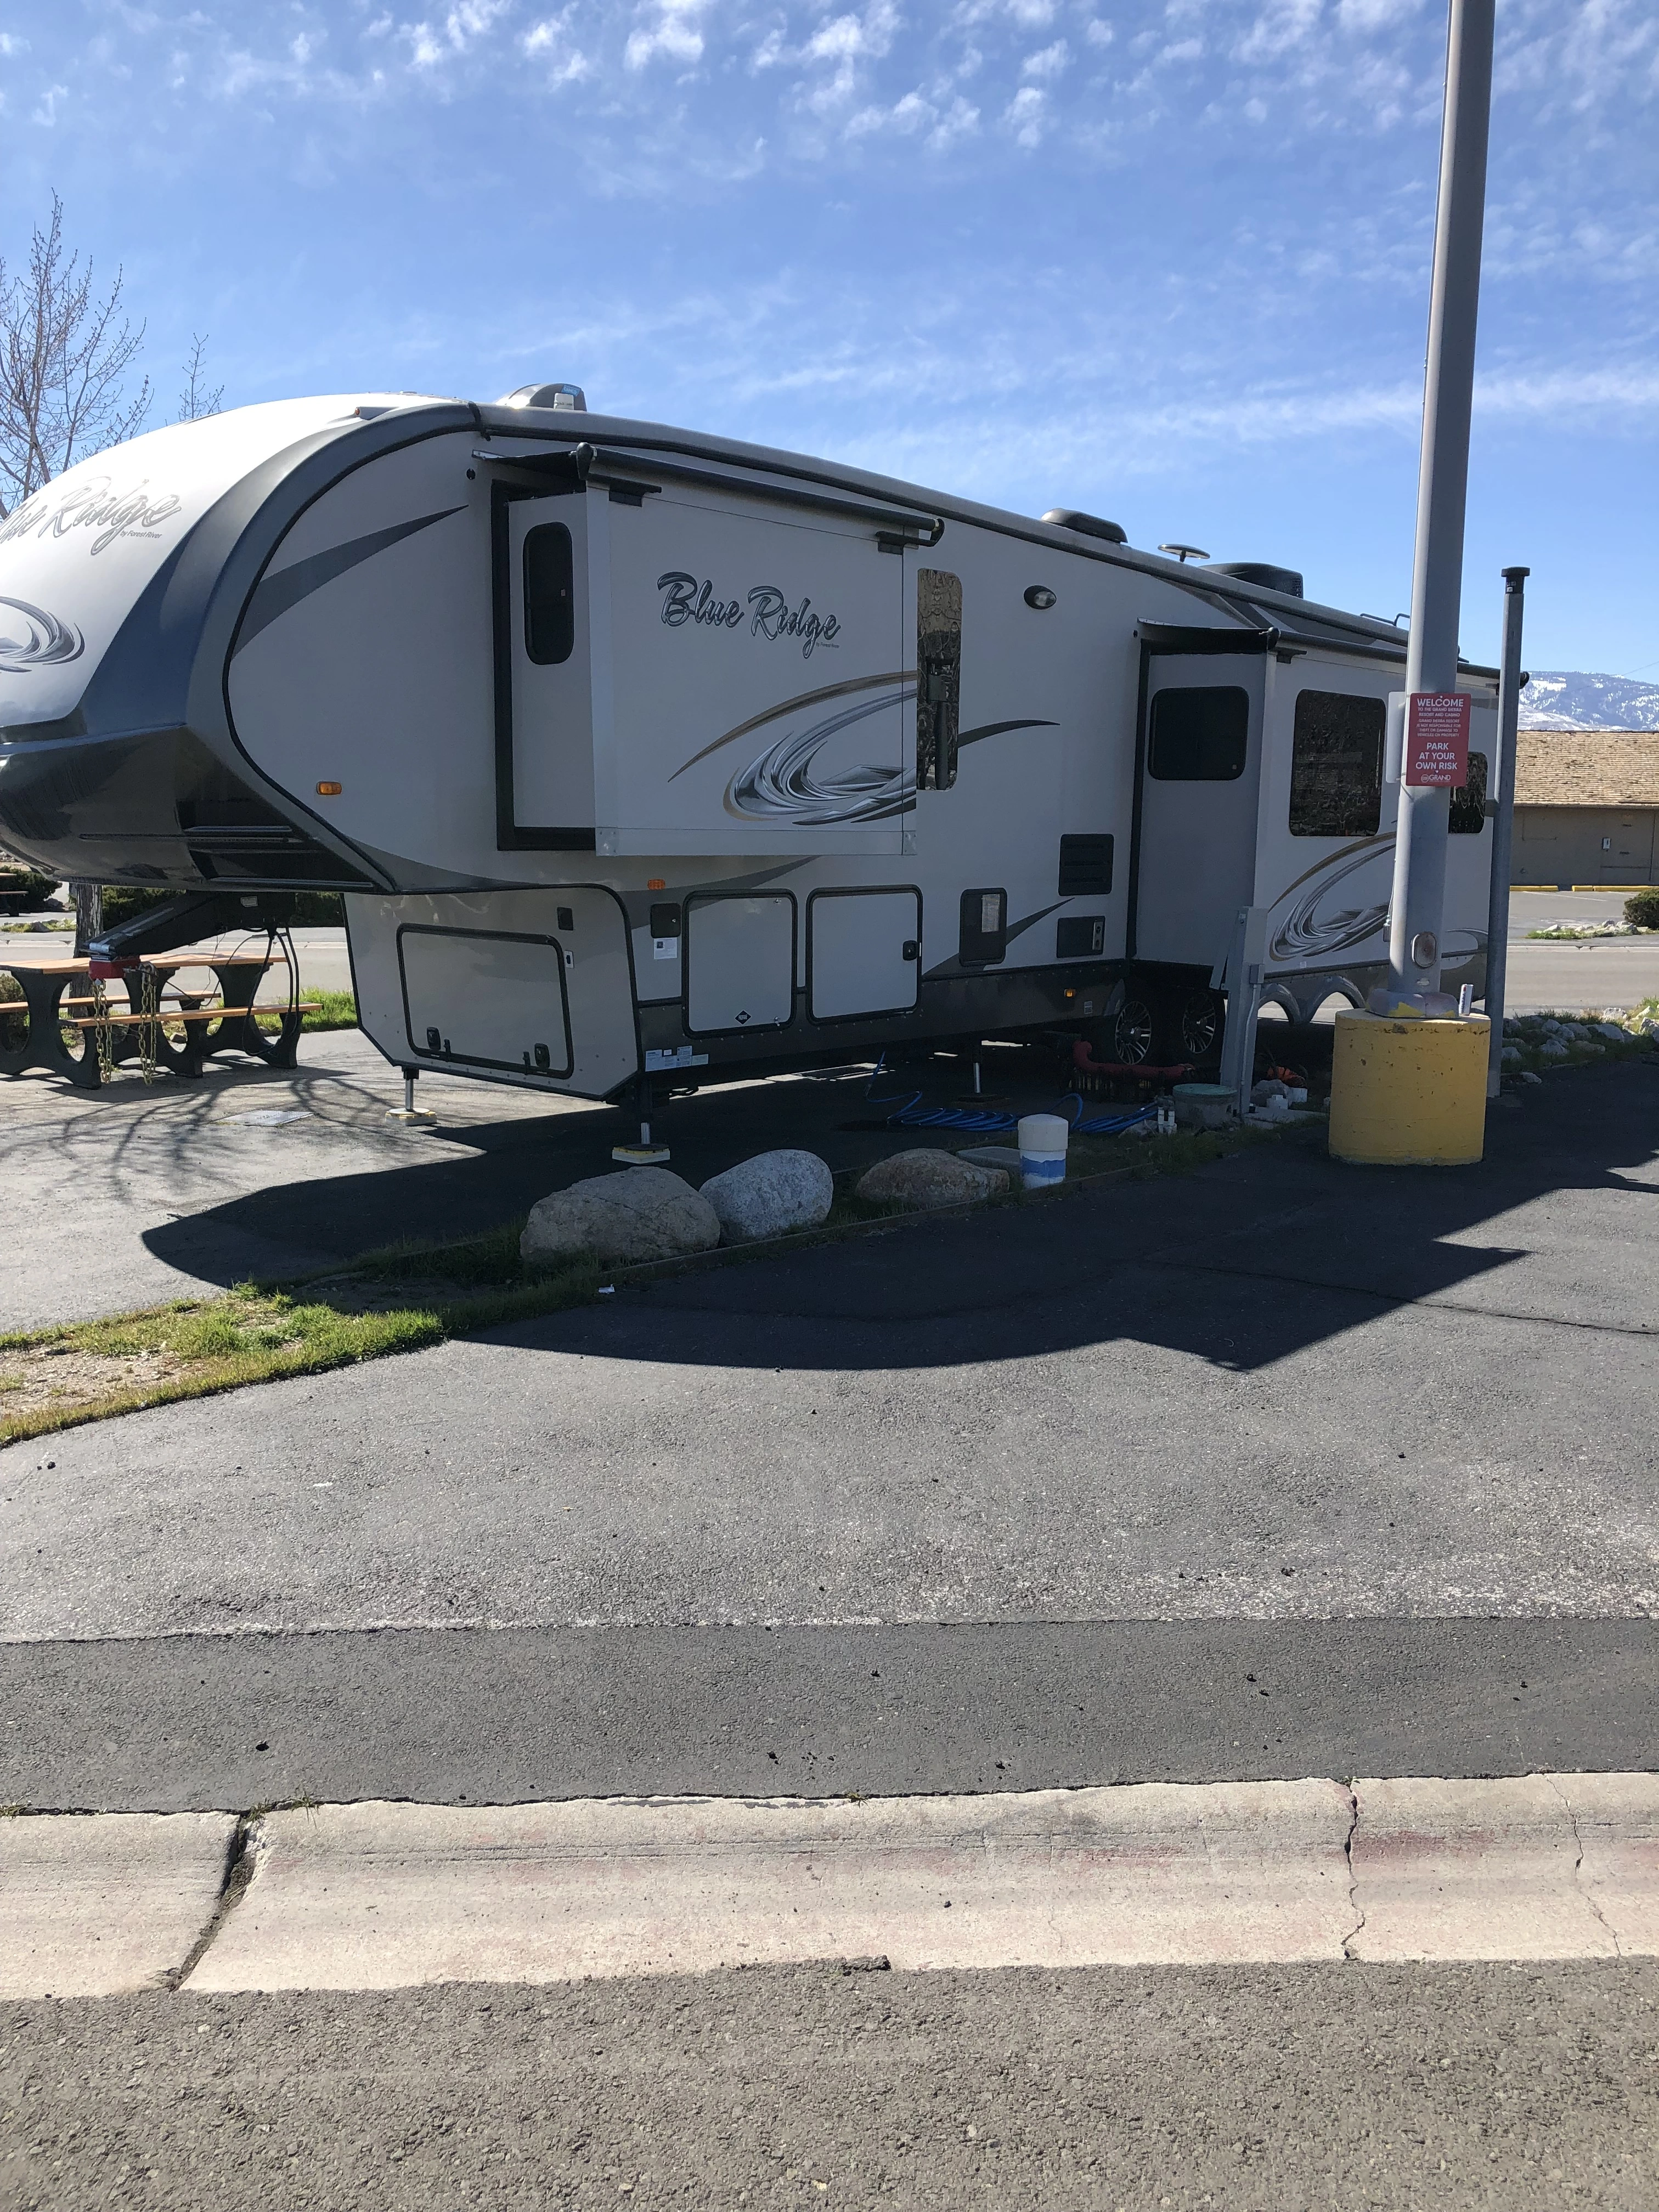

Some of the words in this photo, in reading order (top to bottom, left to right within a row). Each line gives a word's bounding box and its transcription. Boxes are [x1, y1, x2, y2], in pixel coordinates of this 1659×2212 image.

[0, 497, 48, 544] lue
[37, 476, 182, 555] Ridge
[657, 571, 744, 627] Blue
[748, 585, 841, 659] Ridge
[1417, 698, 1464, 707] WELCOME
[1438, 761, 1458, 770] RISK
